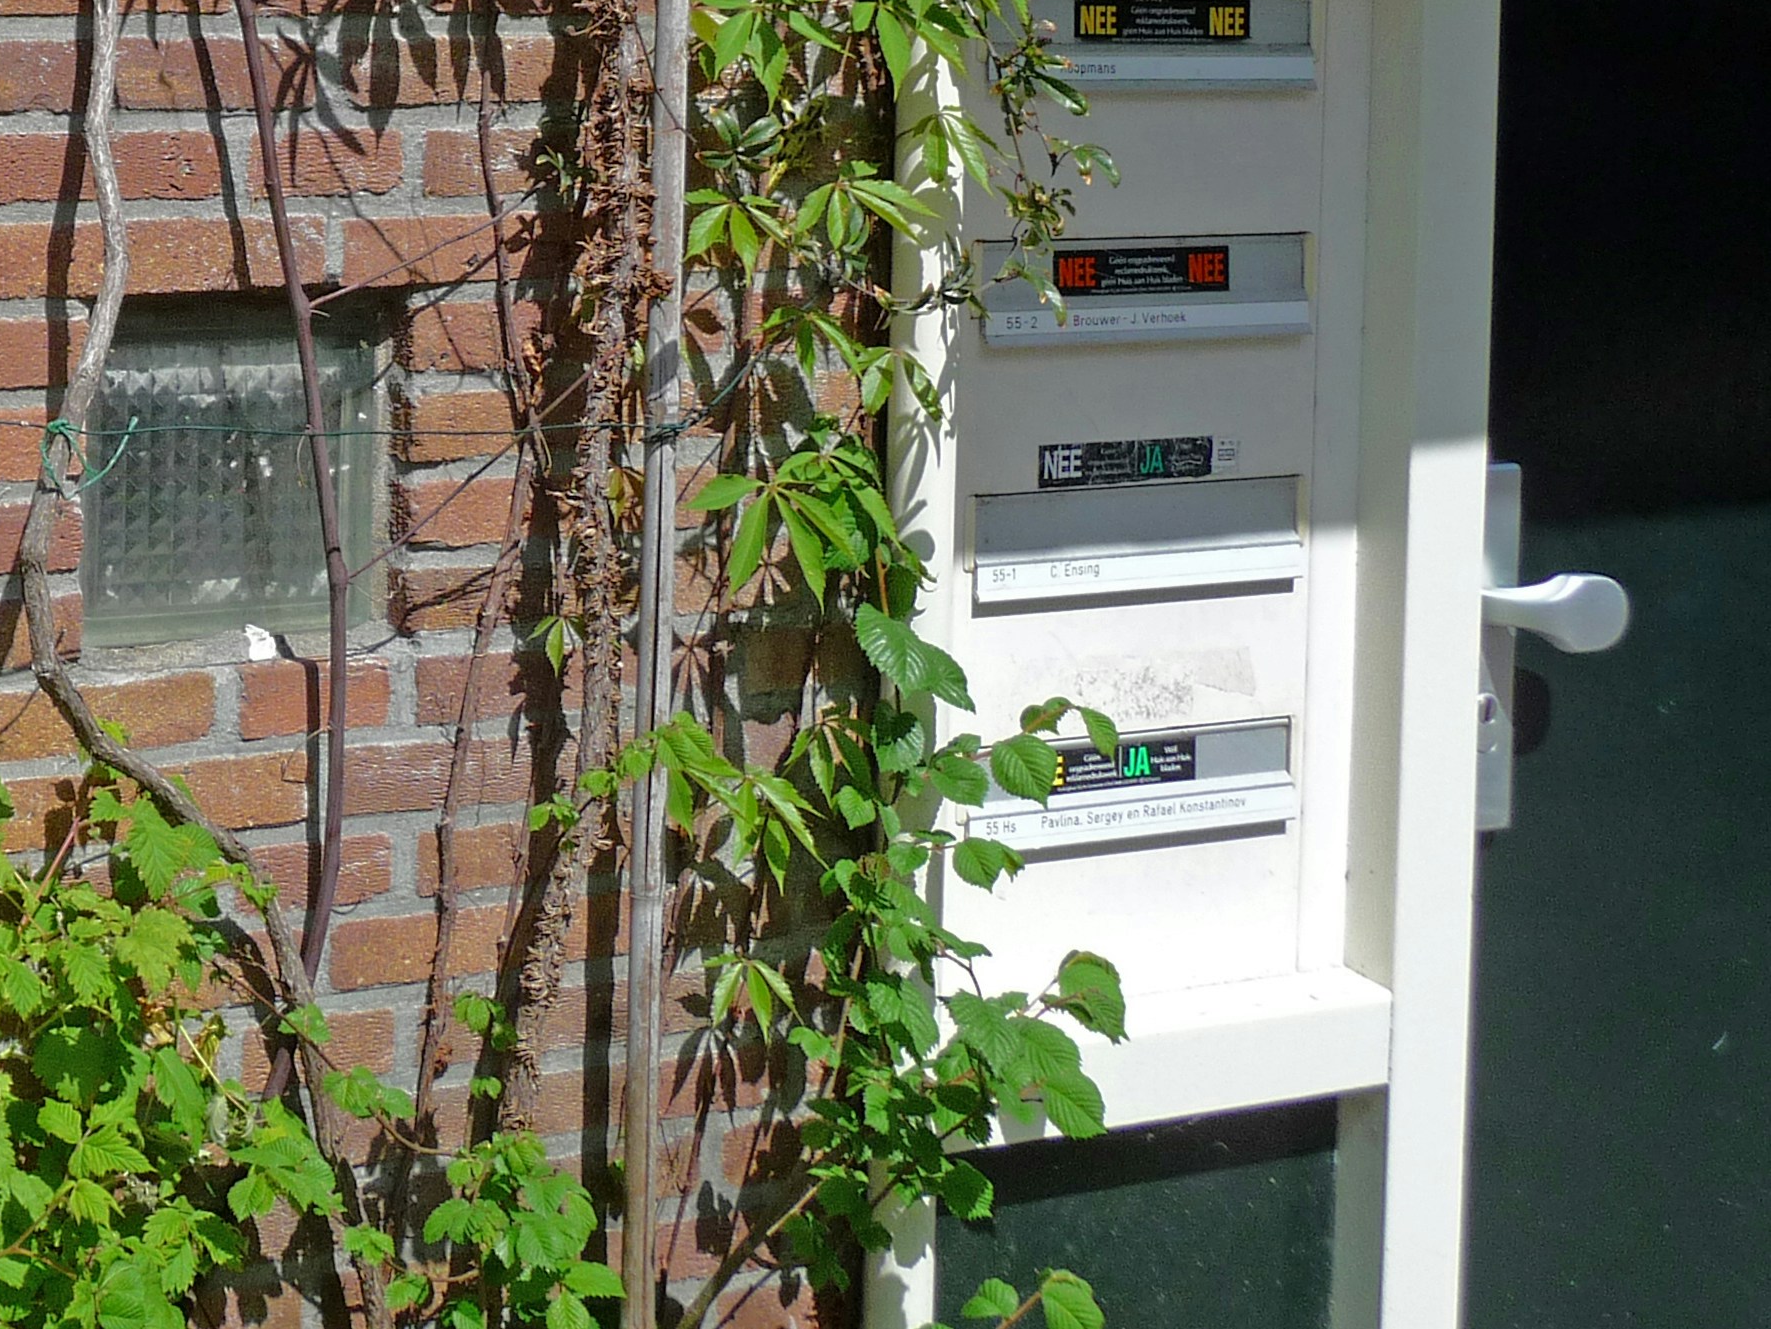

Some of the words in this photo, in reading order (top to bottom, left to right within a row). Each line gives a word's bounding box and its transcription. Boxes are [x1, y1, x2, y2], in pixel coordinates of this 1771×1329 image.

[1080, 5, 1117, 35] NEE
[1209, 6, 1245, 36] NEE
[1059, 257, 1097, 288] NEE
[1188, 252, 1225, 283] NEE
[1043, 448, 1083, 480] NEE
[1140, 445, 1165, 474] JA
[992, 567, 1016, 583] 55-1
[1064, 563, 1100, 578] Ensing
[1123, 746, 1151, 778] JA
[986, 821, 999, 836] 55
[1002, 820, 1017, 833] Hs
[1087, 810, 1123, 825] Sergey
[1127, 808, 1140, 820] en
[1143, 802, 1177, 818] Rafael
[1179, 796, 1246, 814] Konstantinov
